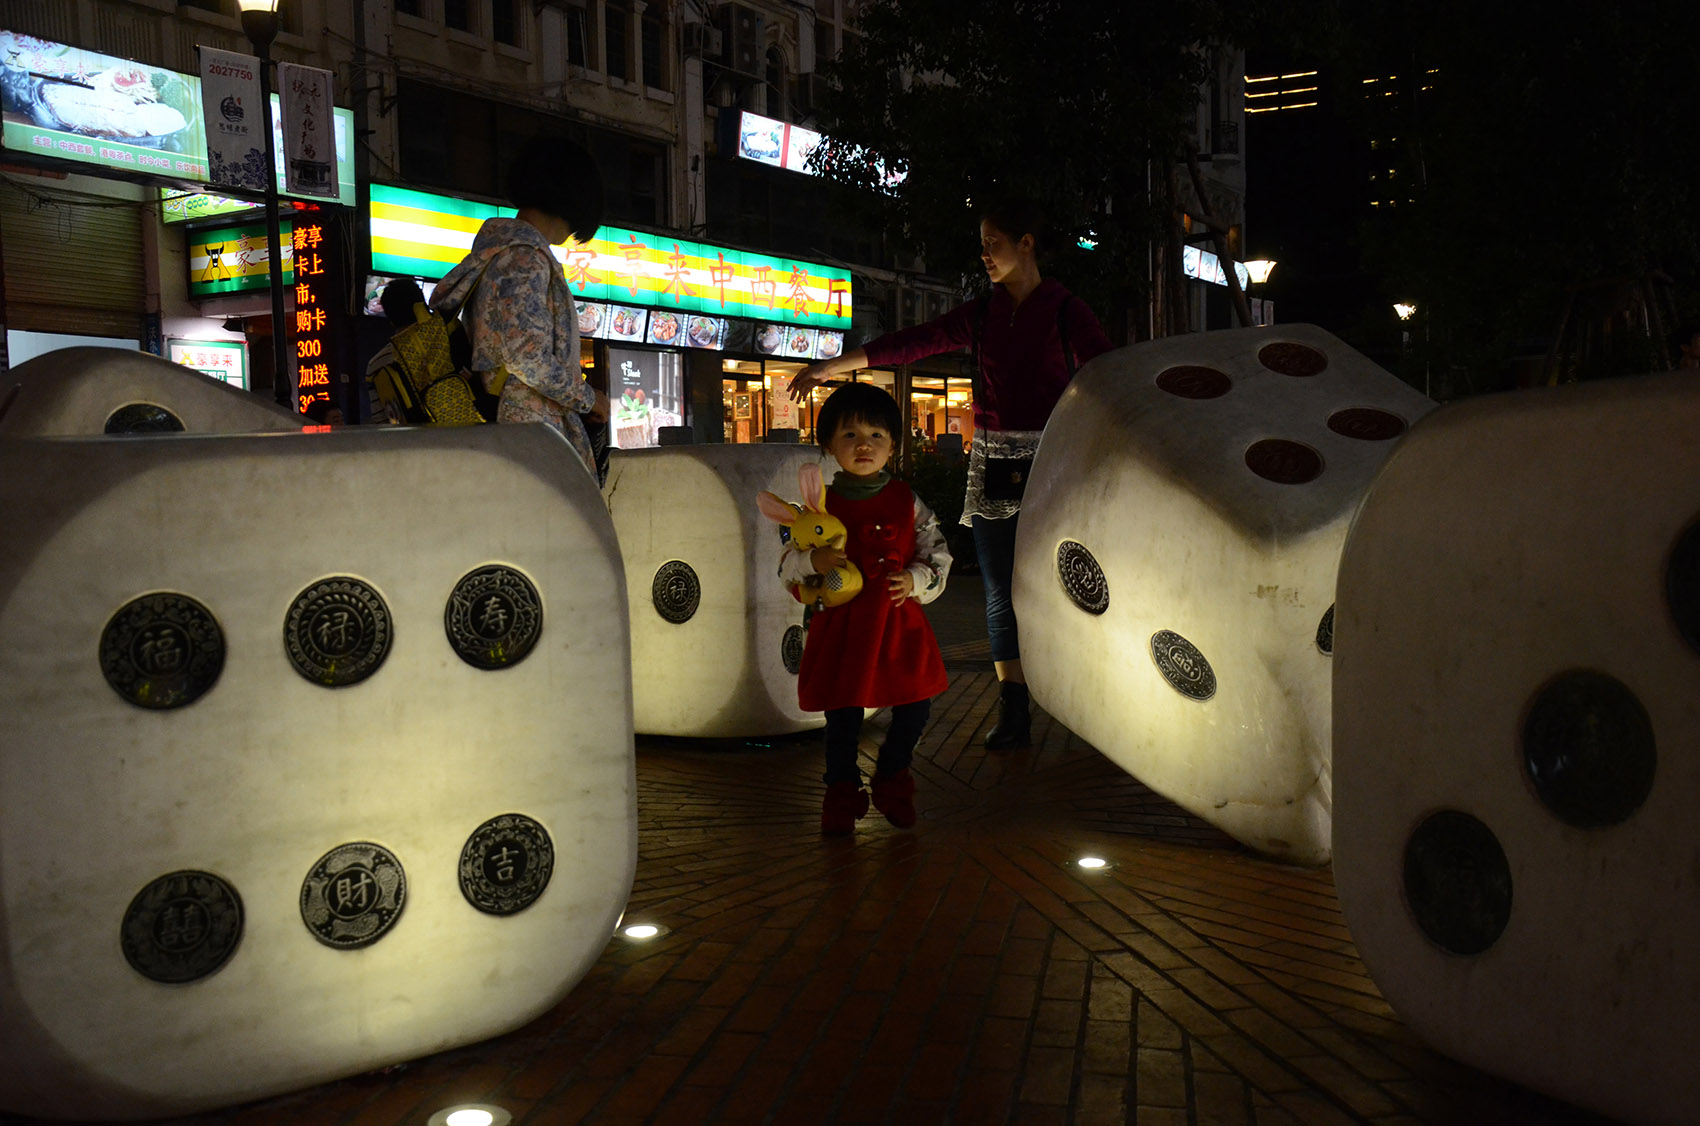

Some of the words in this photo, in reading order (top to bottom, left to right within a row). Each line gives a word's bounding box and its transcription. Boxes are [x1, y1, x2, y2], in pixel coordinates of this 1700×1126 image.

[209, 64, 253, 81] 2027750
[293, 224, 323, 250] 豪享
[294, 253, 324, 277] 卡上
[296, 308, 327, 332] 购卡
[297, 339, 321, 358] 300
[298, 363, 330, 388] 加送
[478, 595, 509, 634] 寿
[317, 611, 350, 649] 禄
[141, 628, 182, 671] 福
[490, 846, 519, 880] 吉
[335, 872, 373, 909] 財
